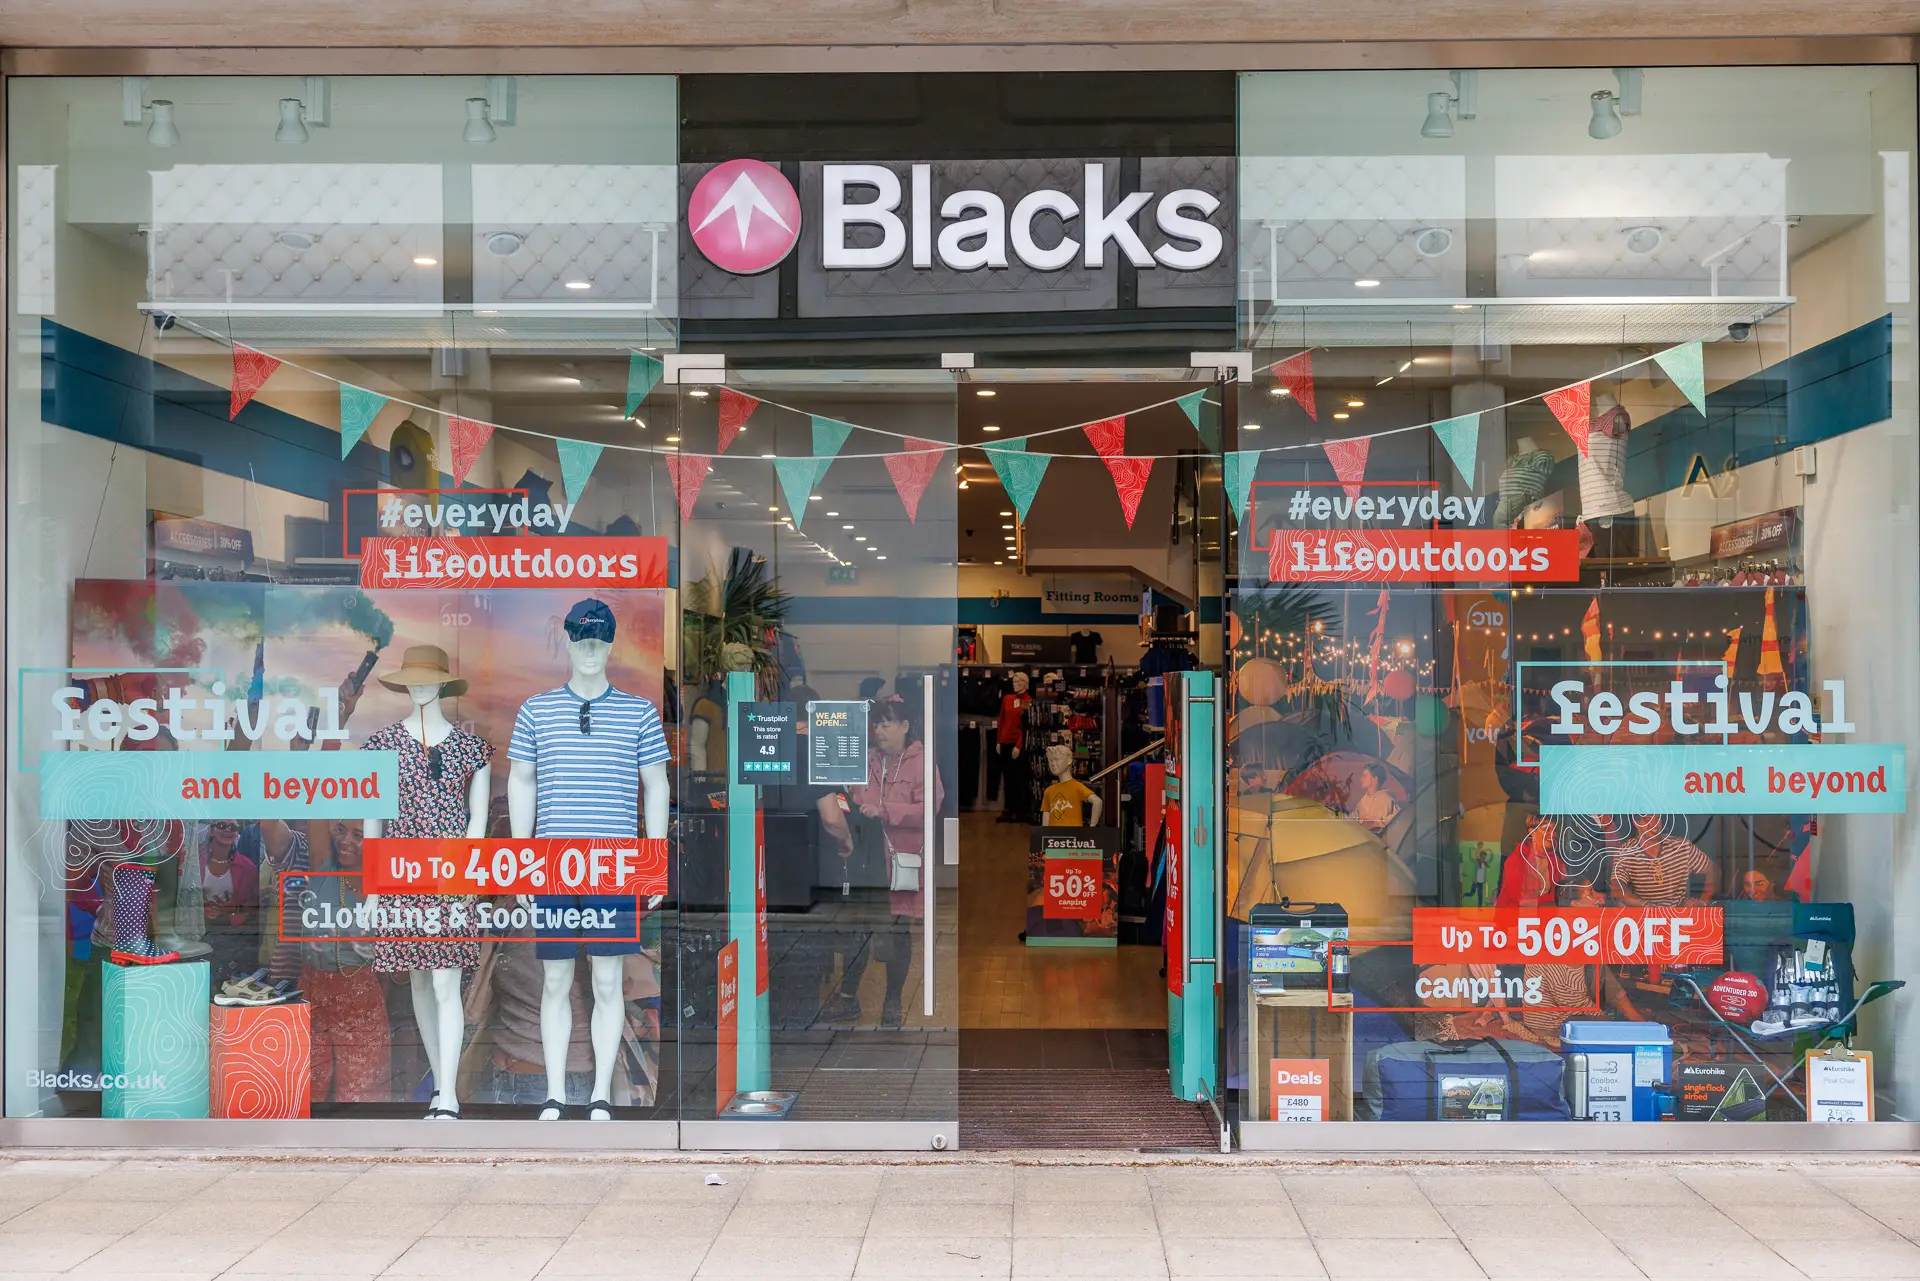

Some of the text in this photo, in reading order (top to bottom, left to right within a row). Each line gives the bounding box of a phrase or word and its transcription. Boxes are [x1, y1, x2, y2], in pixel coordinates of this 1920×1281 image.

[822, 163, 1224, 270] Blacks
[380, 497, 575, 533] #everyday
[1288, 490, 1485, 526] #everyday
[383, 546, 638, 578] lifeoutdoors
[1291, 539, 1550, 572] lifeoutdoors
[1046, 591, 1139, 604] Fitting Rooms
[1011, 643, 1042, 651] TROUSERS
[51, 682, 349, 741] festival
[1550, 674, 1855, 735] festival
[760, 745, 775, 755] 4.9
[181, 772, 380, 805] and beyond
[1684, 766, 1887, 798] and beyond
[1047, 838, 1096, 848] festival
[391, 848, 639, 888] Up To 40% OFF
[1049, 875, 1096, 897] 50%
[302, 900, 617, 934] clothing & footwear
[1441, 917, 1693, 956] Up To 50% OFF
[1415, 969, 1543, 1004] camping
[1713, 985, 1747, 996] ADVENTURER
[25, 1069, 166, 1090] Blacks.co.uk
[1277, 1071, 1322, 1085] Deals
[1695, 1067, 1725, 1075] Eurohike
[1683, 1084, 1726, 1093] single flock
[1287, 1098, 1309, 1107] £480
[1836, 1109, 1852, 1117] FOR
[1593, 1111, 1621, 1122] £13
